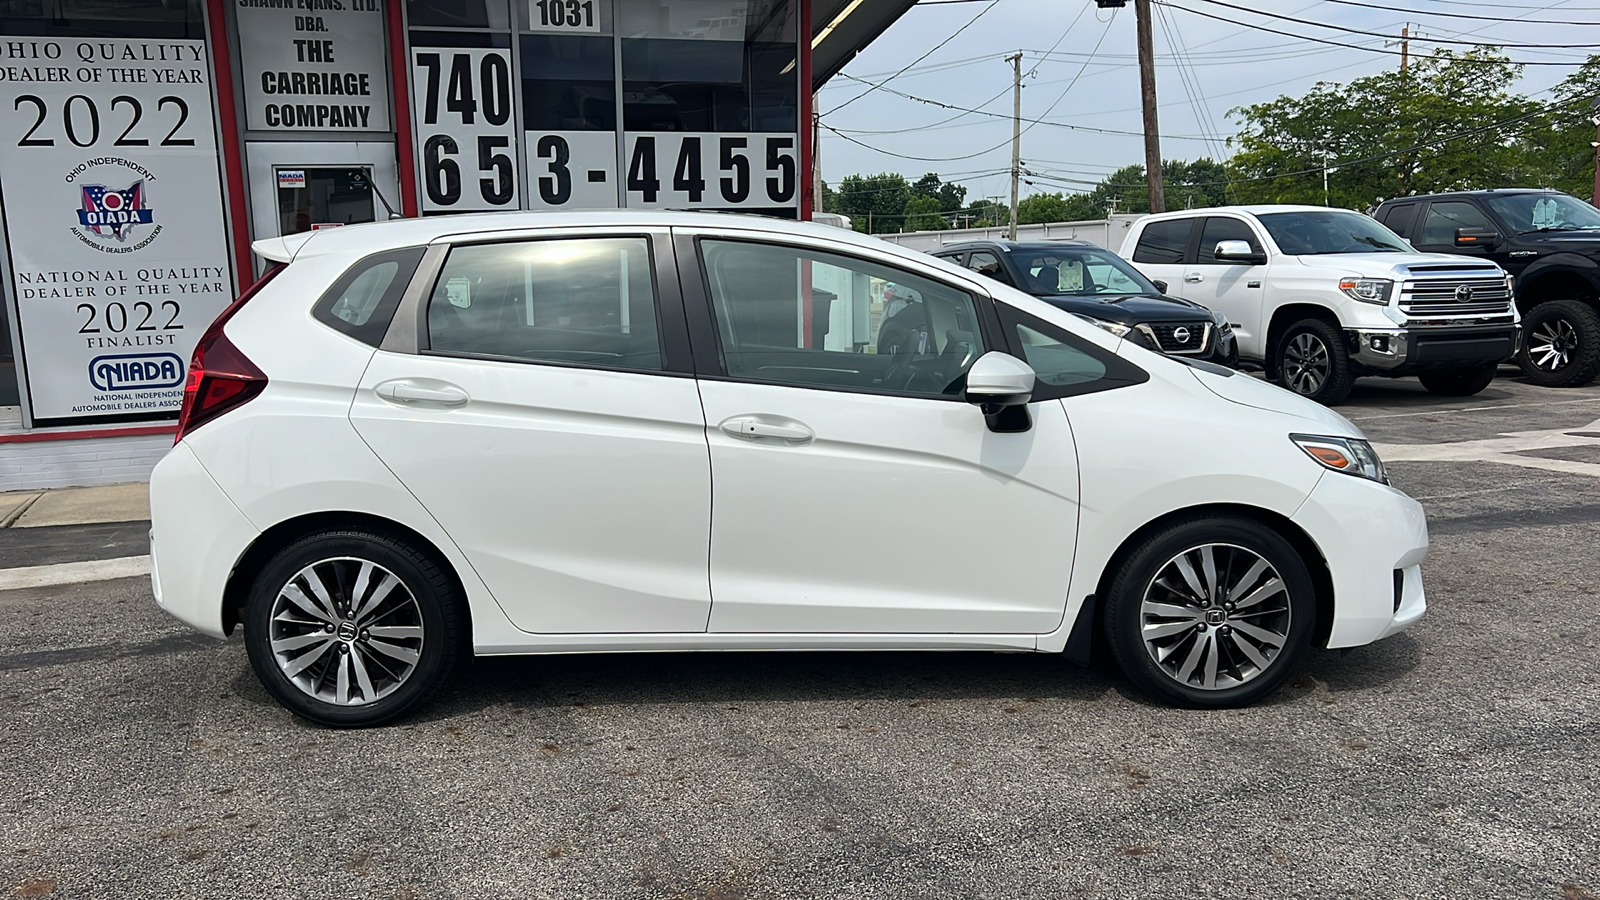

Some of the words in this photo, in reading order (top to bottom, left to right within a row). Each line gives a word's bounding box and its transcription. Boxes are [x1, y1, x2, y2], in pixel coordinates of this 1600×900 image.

[294, 16, 329, 32] DBA.
[536, 0, 593, 27] 1031
[0, 42, 61, 60] HIO
[77, 43, 203, 63] QUALITY
[293, 39, 335, 63] THE
[76, 68, 102, 83] OF
[107, 68, 147, 83] THE
[152, 69, 204, 84] YEAR
[261, 71, 371, 96] CARRIAGE
[416, 53, 510, 126] 740
[13, 94, 195, 148] 2022
[265, 104, 370, 128] COMPANY
[65, 163, 87, 183] OHIO
[87, 157, 157, 182] INDEPENDENT
[87, 210, 141, 225] OIADA
[70, 226, 105, 252] AUTOMOBILE
[105, 246, 133, 254] DEALERS
[133, 224, 163, 252] ASSOCIATION
[19, 270, 128, 284] NATIONAL
[137, 267, 224, 281] QUALITY
[24, 286, 97, 299] DEALER
[105, 285, 128, 296] OF
[136, 284, 171, 295] THE
[178, 282, 224, 294] YEAR
[76, 300, 184, 334] 2022
[87, 334, 176, 349] FINALIST
[97, 360, 176, 387] NIADA
[72, 403, 122, 412] AUTOMOBILE
[124, 401, 157, 410] DEALERS
[94, 393, 133, 402] NATIONAL
[135, 391, 184, 400] INDEPENDEN
